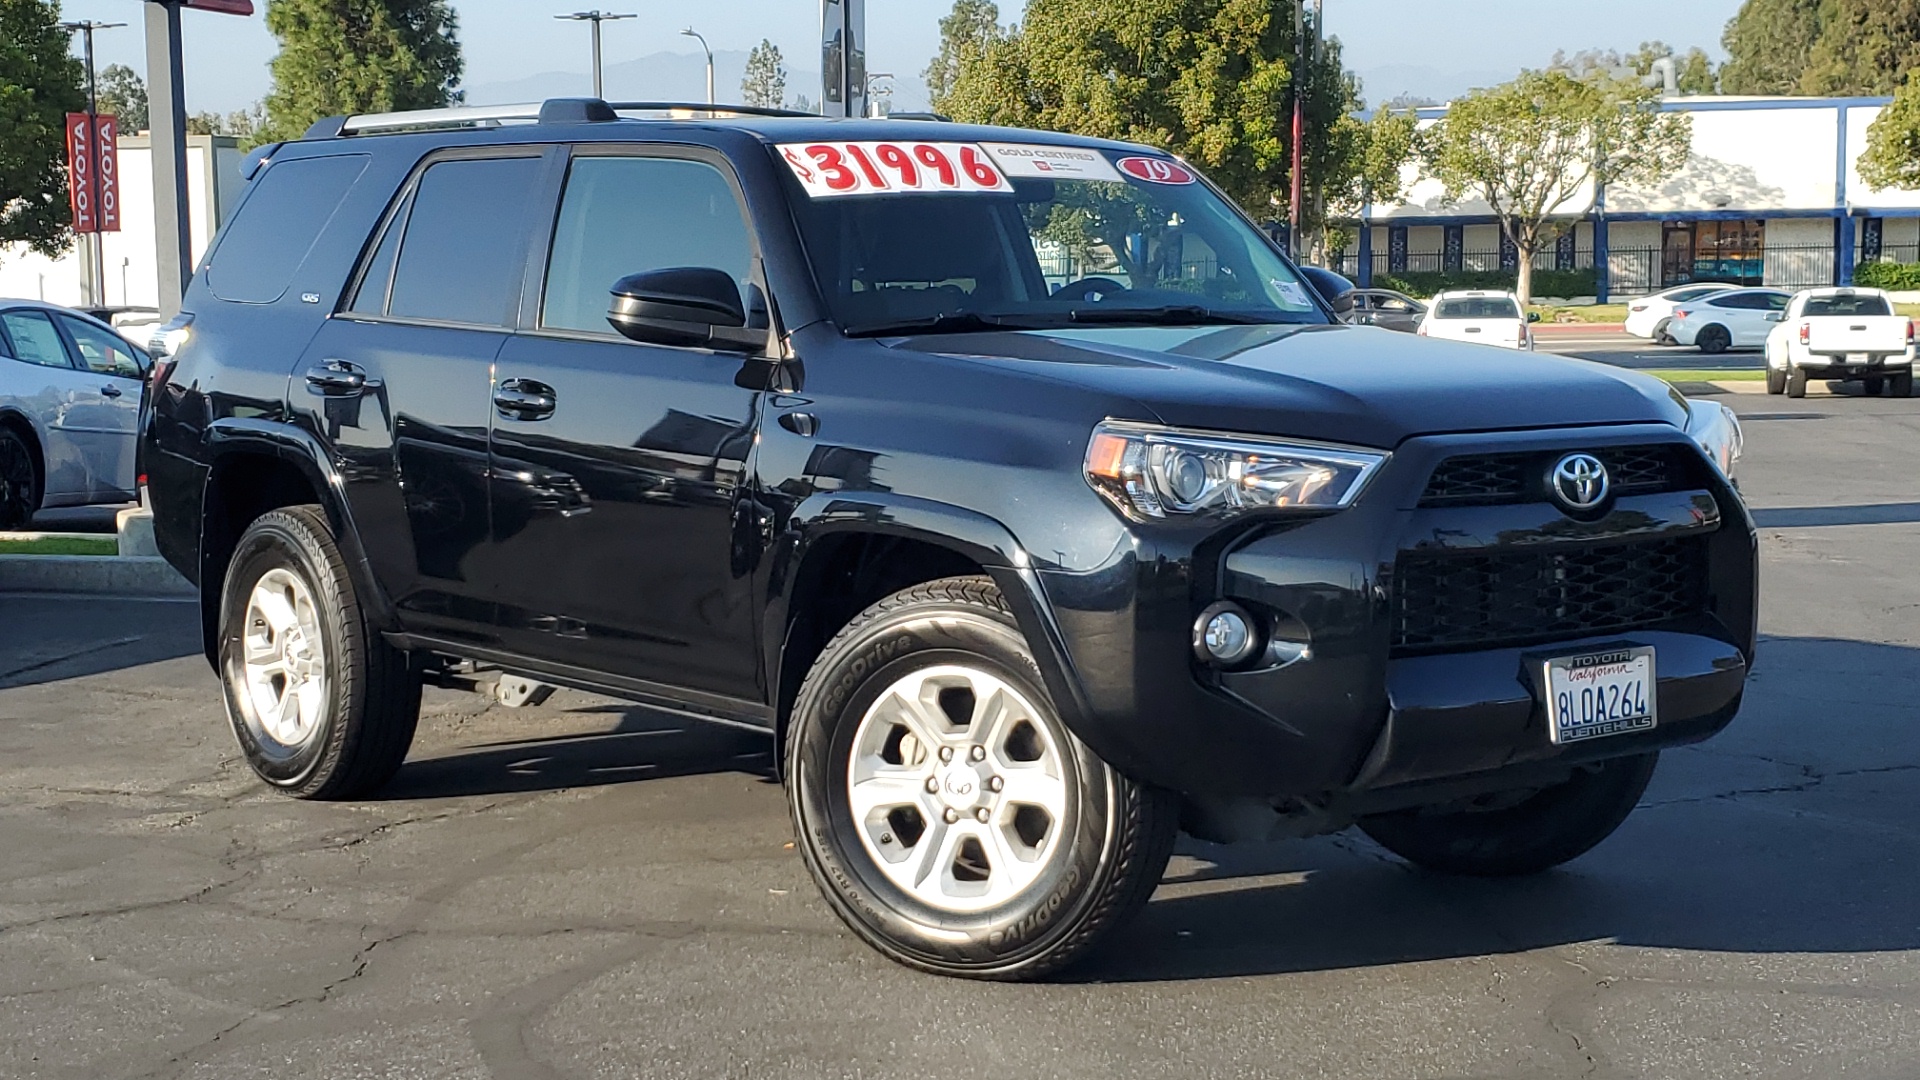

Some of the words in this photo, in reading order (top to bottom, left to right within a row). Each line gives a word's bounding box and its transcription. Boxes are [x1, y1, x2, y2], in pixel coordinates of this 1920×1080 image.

[997, 148, 1033, 157] GOLD
[1034, 151, 1095, 161] CERTIFIED
[74, 121, 89, 227] TOYOTA
[101, 122, 115, 226] TOYOTA
[784, 144, 1001, 190] $31996
[1139, 159, 1172, 180] 19
[1574, 651, 1630, 667] TOYOTA
[1568, 664, 1634, 685] California
[1558, 680, 1646, 728] 8LOA264
[1561, 722, 1611, 741] PUENTE
[1613, 717, 1652, 732] HILLS
